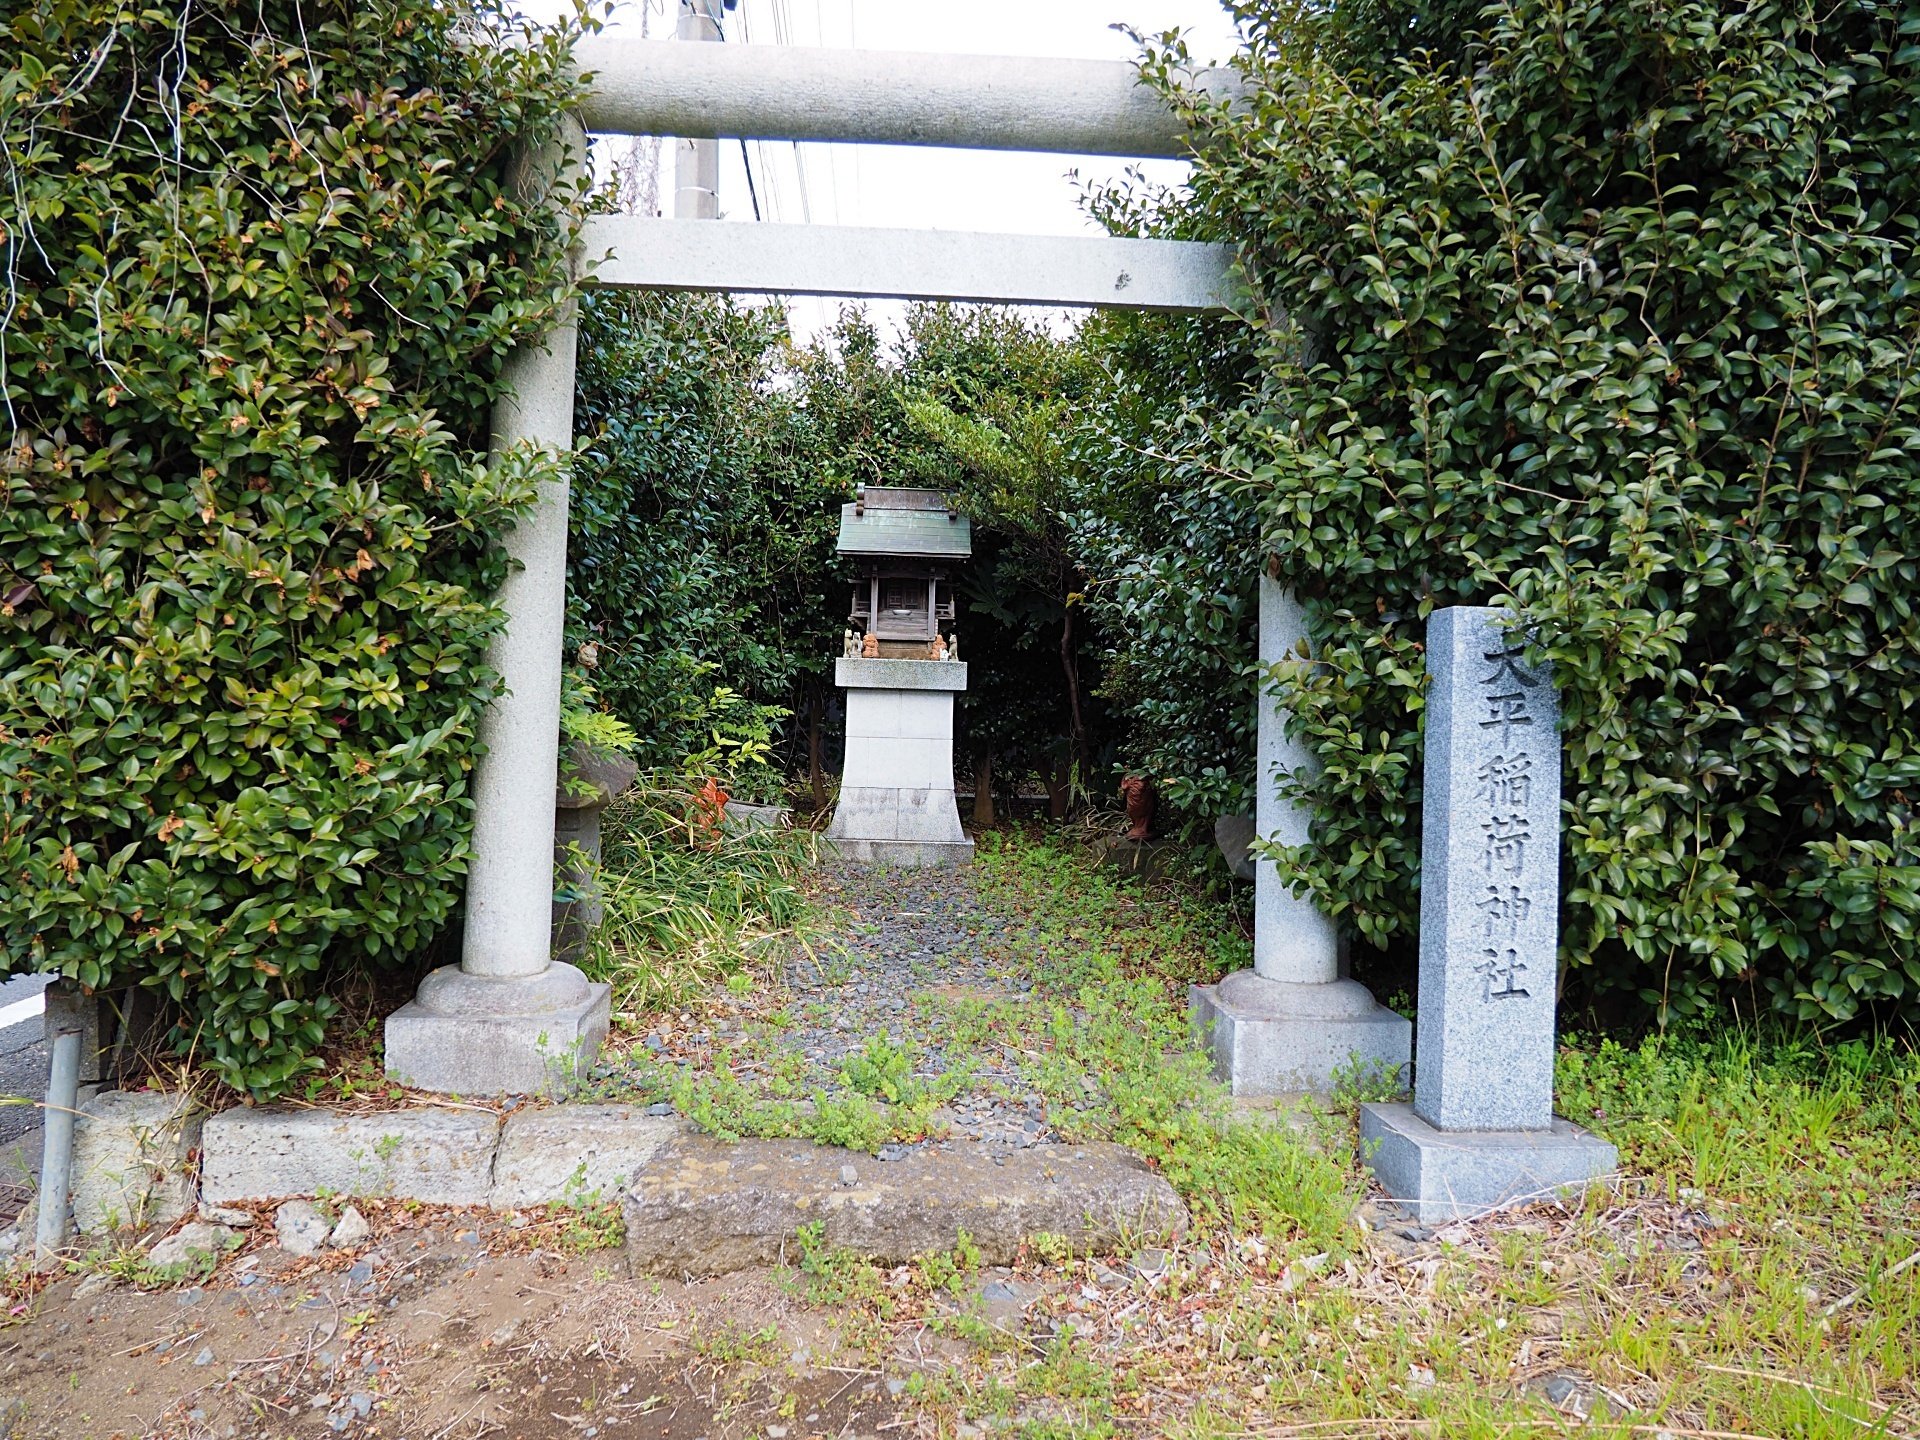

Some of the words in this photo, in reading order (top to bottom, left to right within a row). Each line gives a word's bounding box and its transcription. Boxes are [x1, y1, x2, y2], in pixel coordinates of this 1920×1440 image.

[1472, 634, 1539, 1003] 大平稲荷神社
